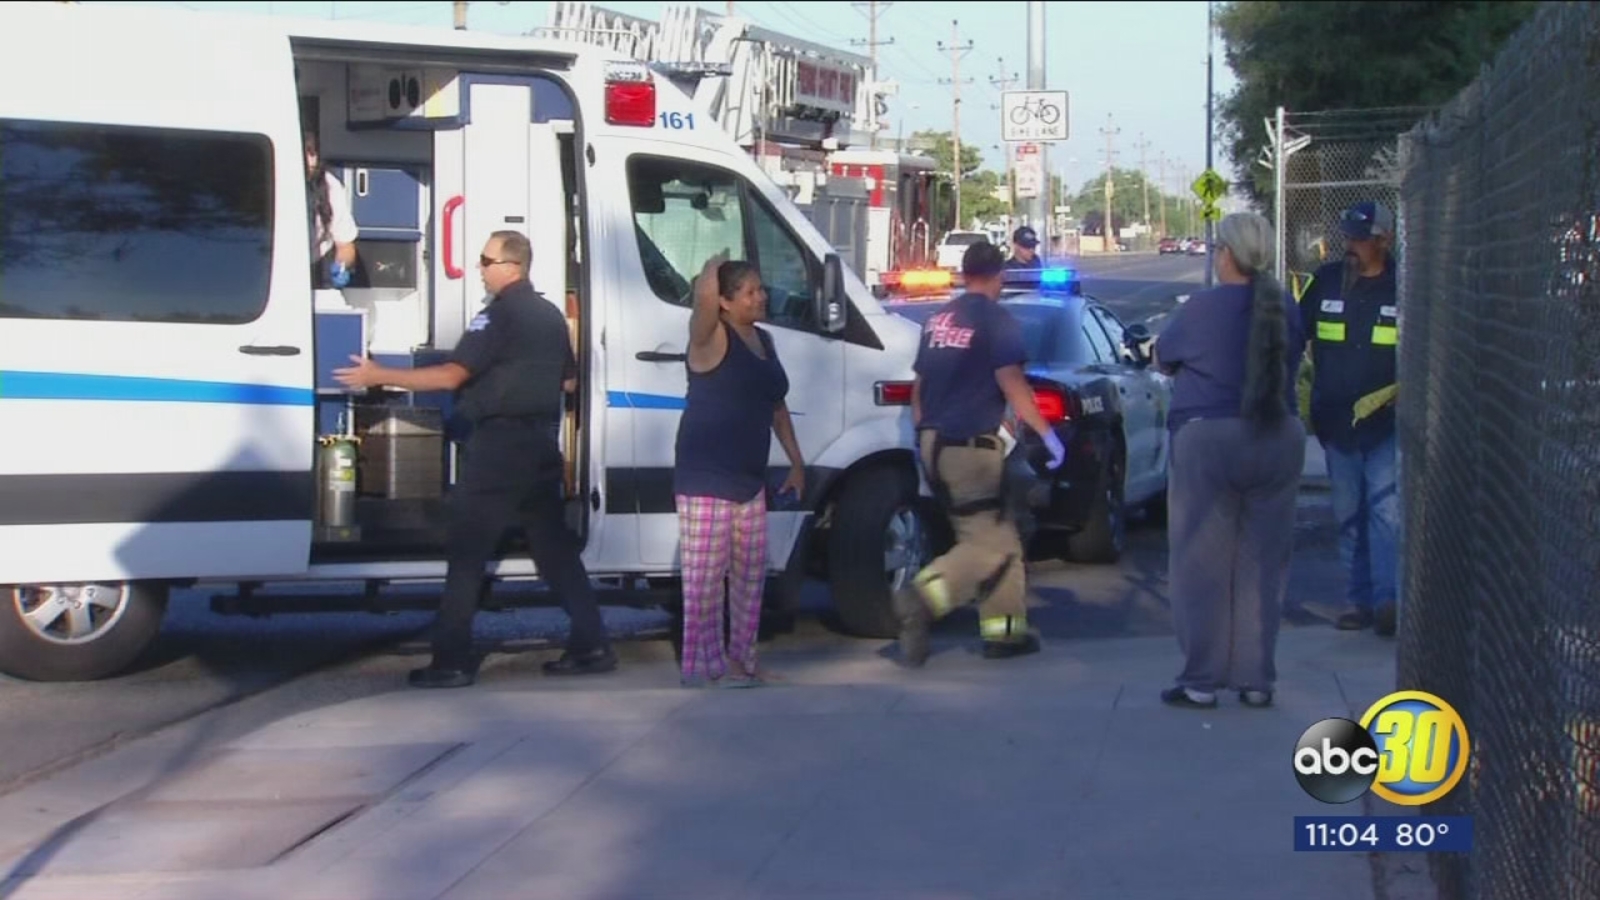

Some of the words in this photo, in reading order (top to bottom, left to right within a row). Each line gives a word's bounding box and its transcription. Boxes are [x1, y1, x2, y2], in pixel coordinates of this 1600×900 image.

[659, 111, 694, 130] 161
[1034, 125, 1059, 137] LANE
[928, 327, 975, 348] FIRE
